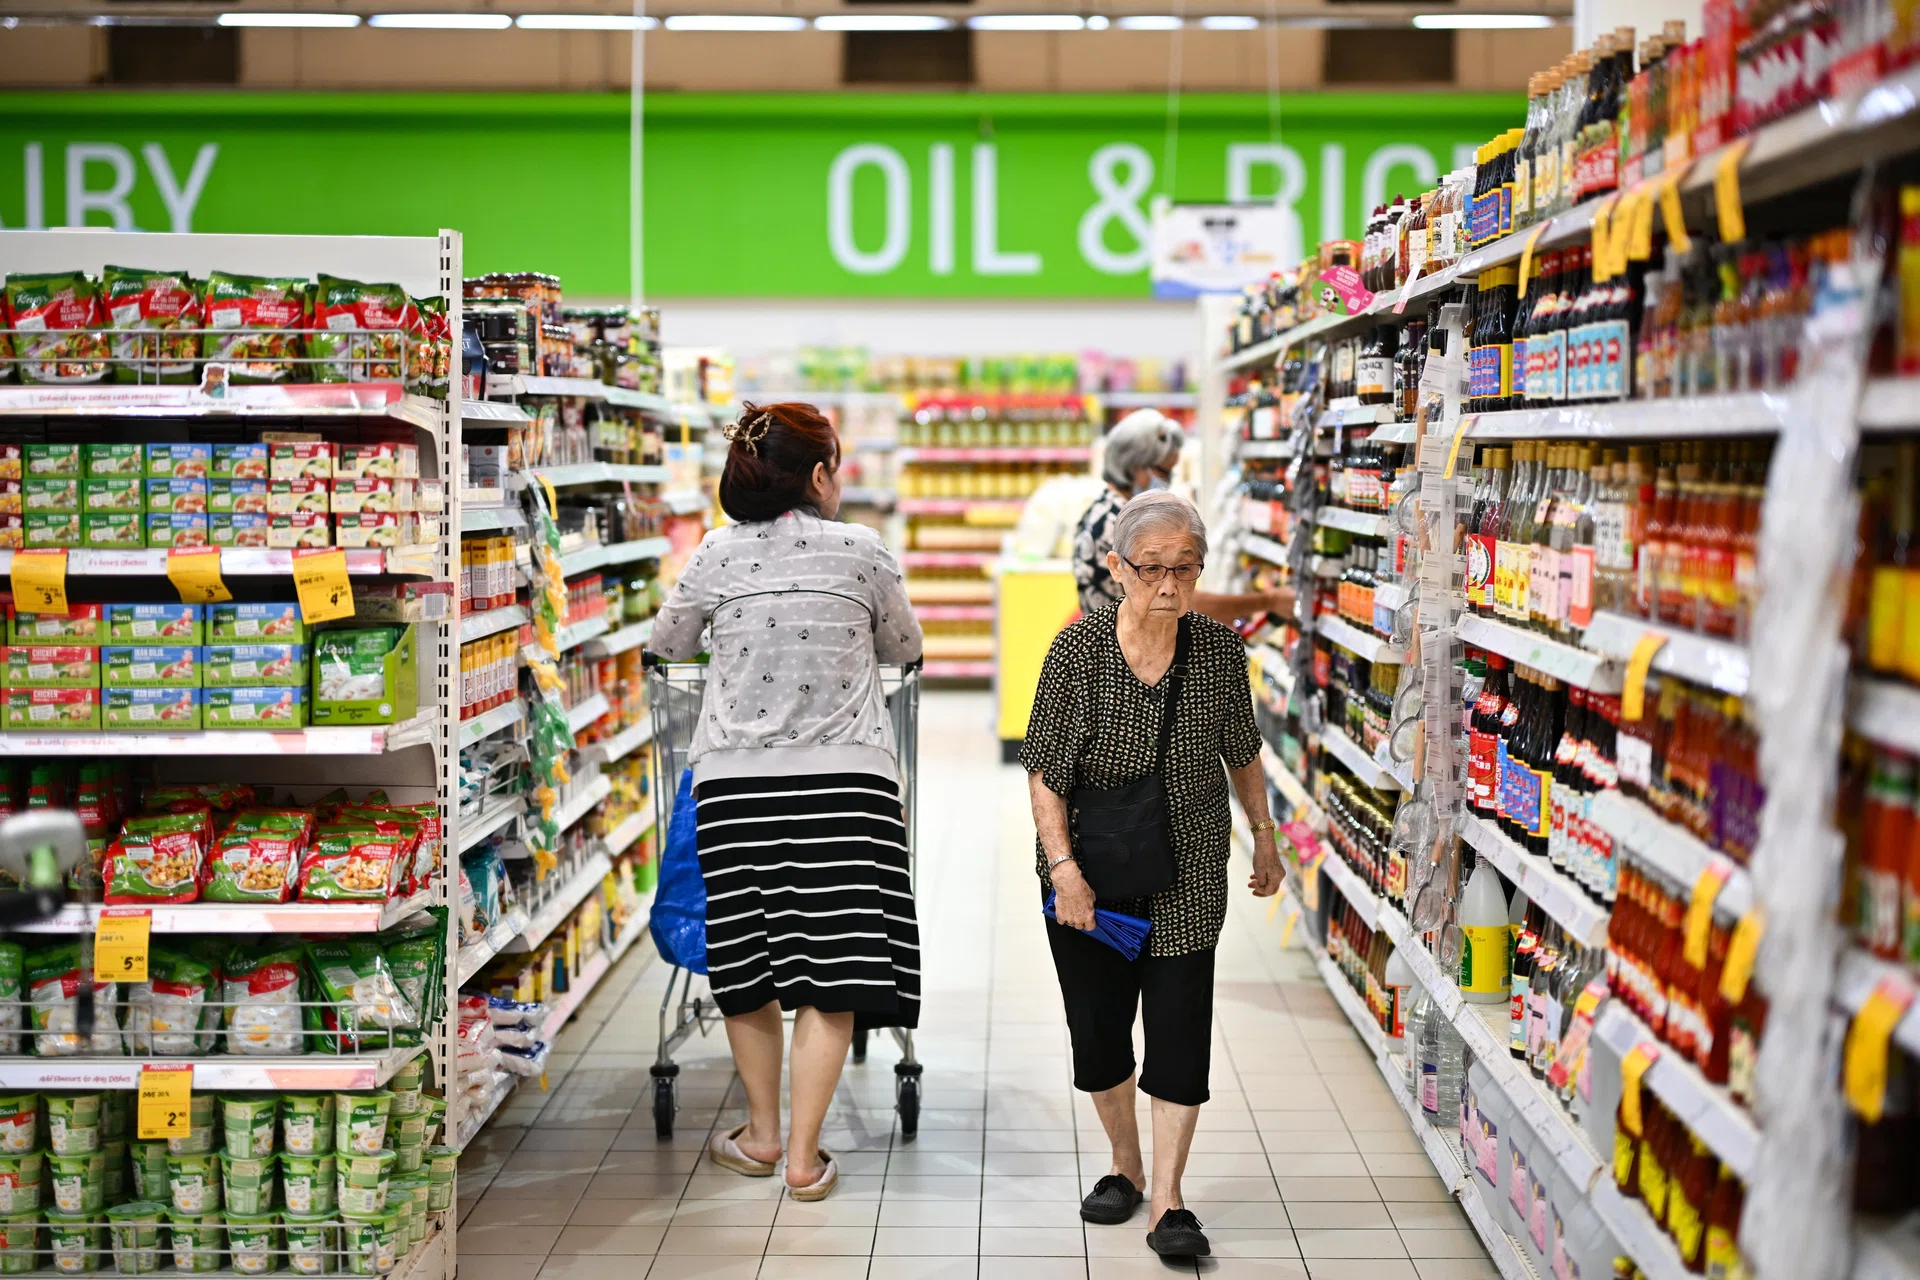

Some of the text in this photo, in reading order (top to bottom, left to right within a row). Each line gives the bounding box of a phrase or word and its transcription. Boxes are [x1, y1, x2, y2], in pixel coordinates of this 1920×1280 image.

[0, 142, 220, 233] IRY
[827, 143, 1479, 274] OIL & RIC
[112, 280, 143, 290] Knorr
[44, 592, 52, 604] 3
[205, 589, 215, 598] 3
[331, 593, 338, 606] 4
[32, 649, 57, 657] CHICKEN
[33, 690, 58, 698] CHICKEN
[322, 843, 349, 852] Knorr
[107, 909, 146, 917] PROMOTION
[315, 949, 350, 957] Knorr
[354, 1107, 375, 1115] Knorr
